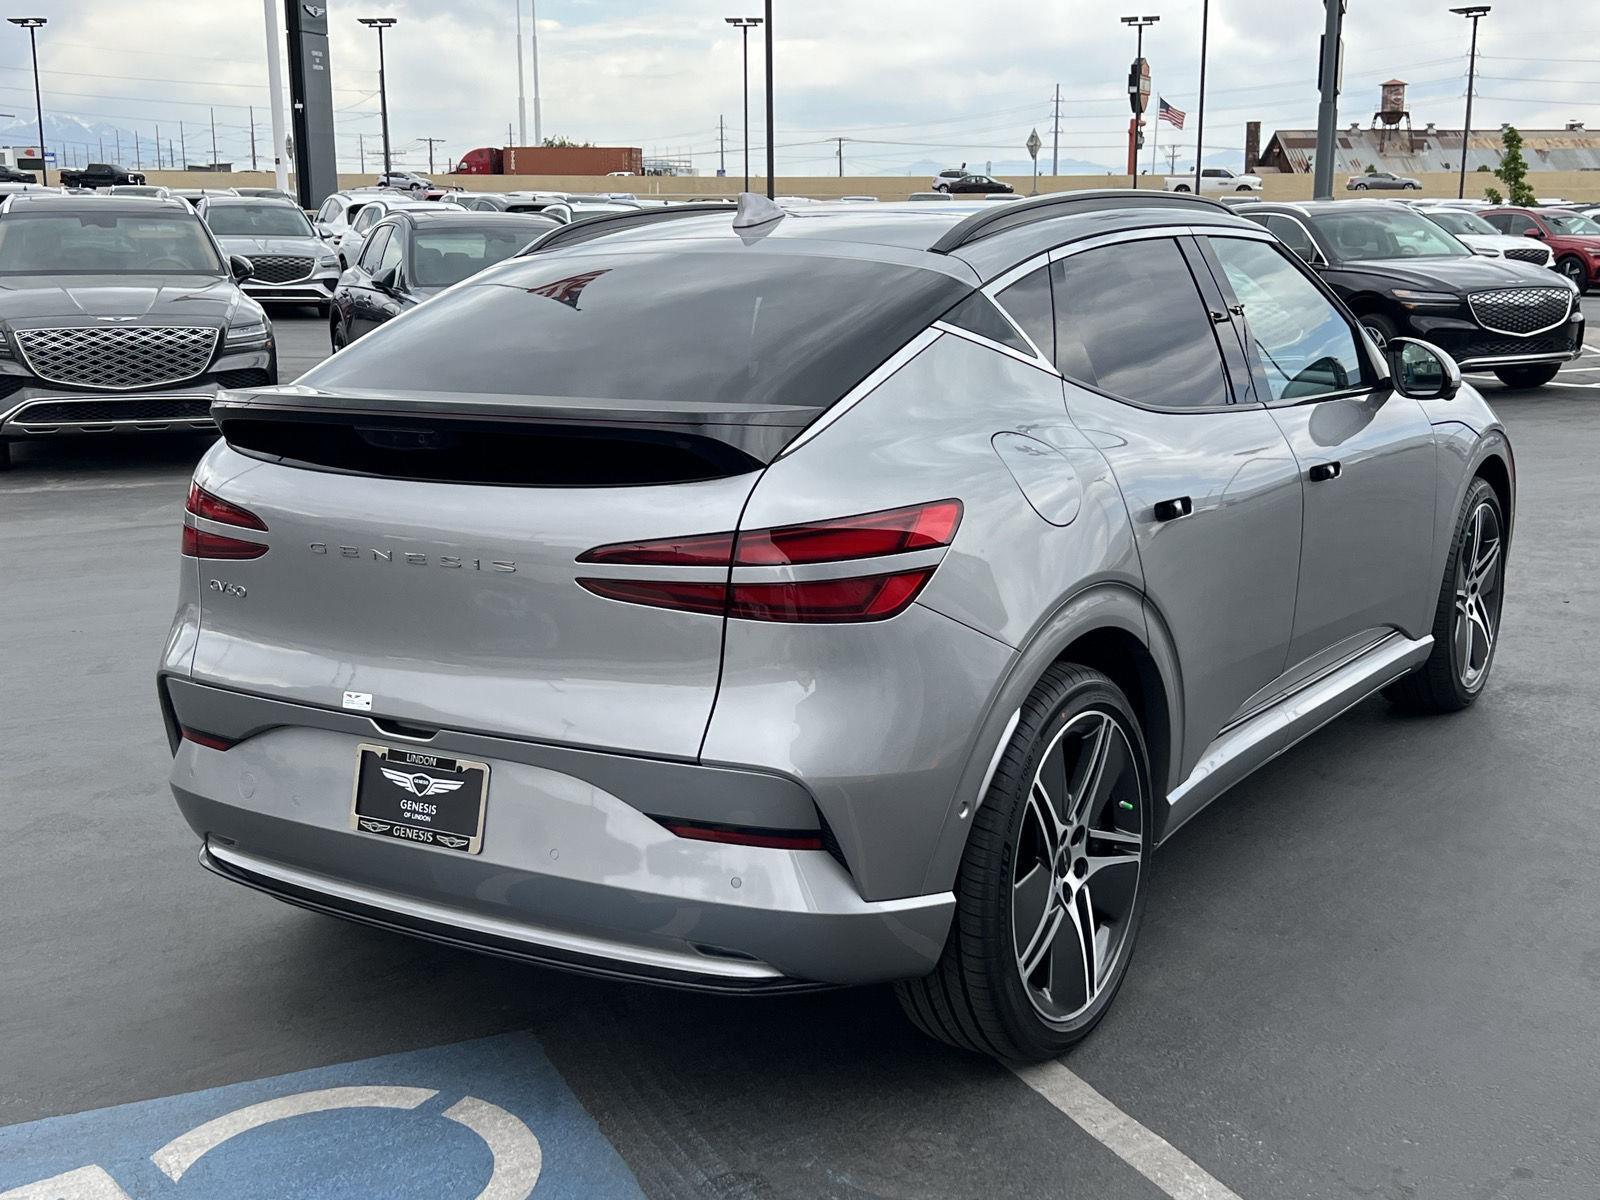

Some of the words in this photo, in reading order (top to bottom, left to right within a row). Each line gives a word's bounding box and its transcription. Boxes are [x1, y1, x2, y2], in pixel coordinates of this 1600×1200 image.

[310, 542, 517, 573] GENESIS
[406, 753, 437, 766] LINDON
[400, 799, 437, 815] GENESIS
[403, 811, 412, 819] OF
[411, 812, 431, 822] LINDON
[393, 825, 433, 842] GENESIS
